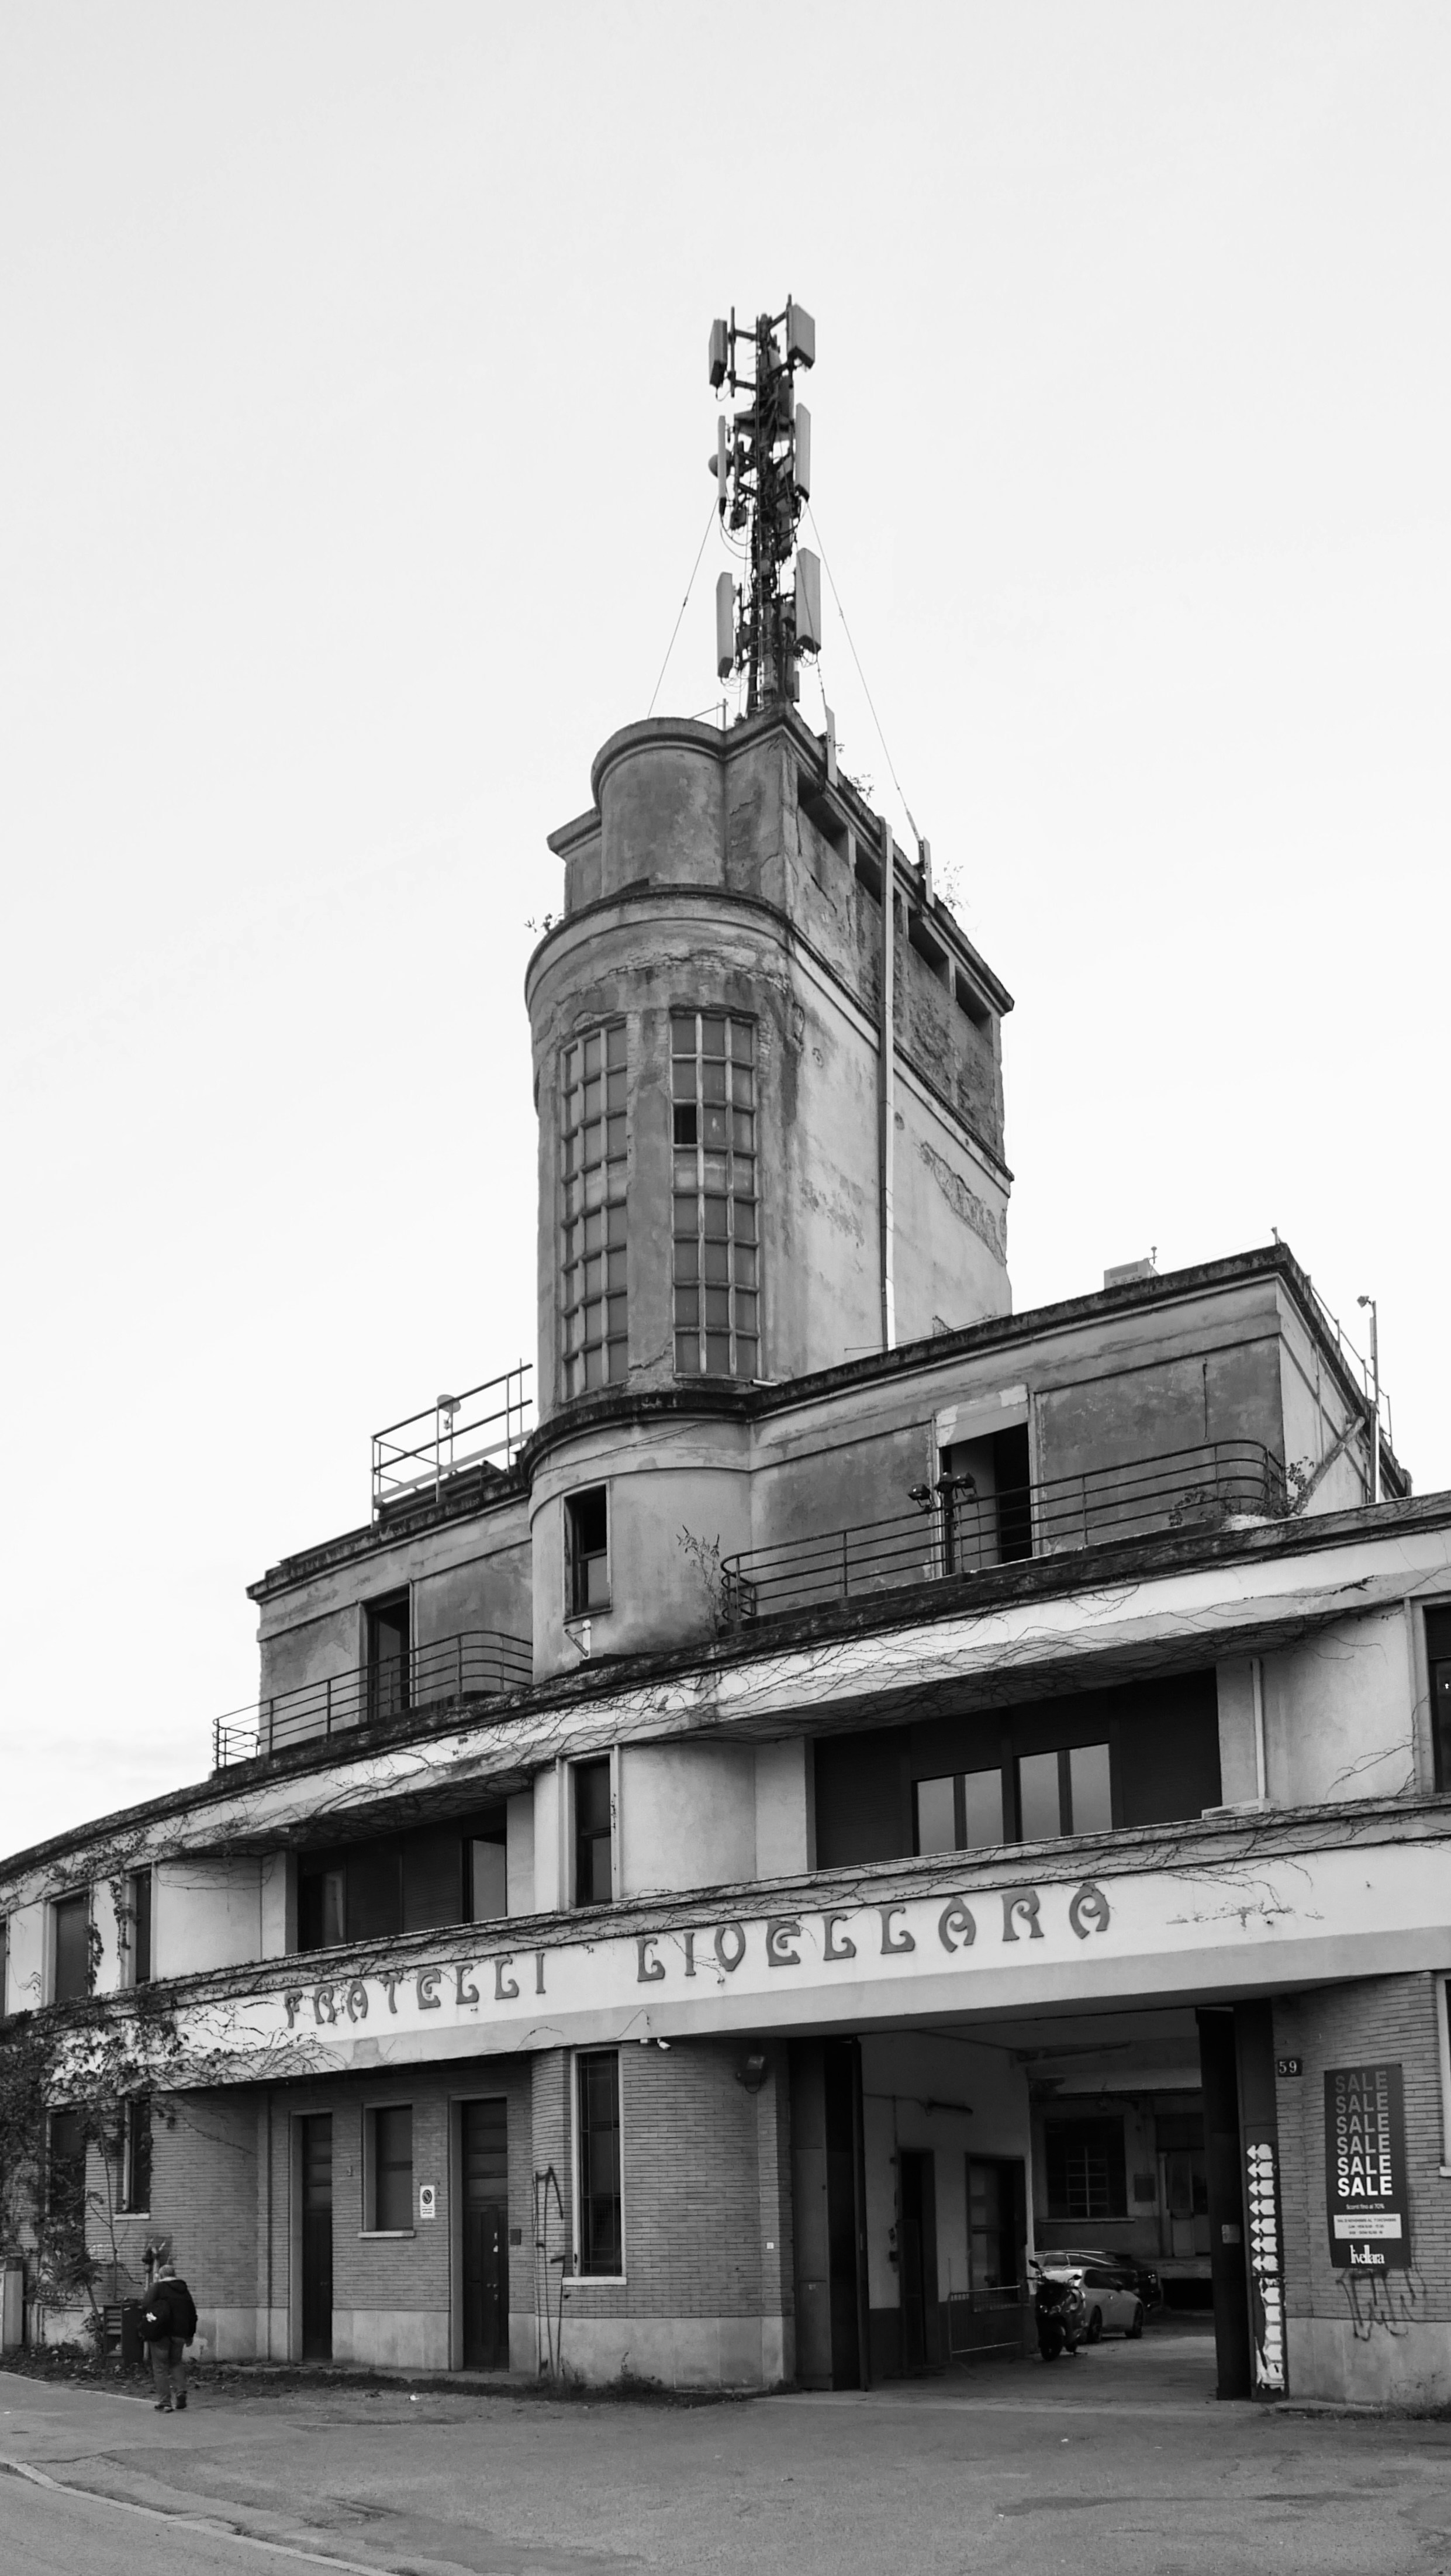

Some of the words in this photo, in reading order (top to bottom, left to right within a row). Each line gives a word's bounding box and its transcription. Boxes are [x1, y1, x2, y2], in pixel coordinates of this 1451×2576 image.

[284, 1952, 546, 2029] FRATELLI
[637, 1882, 1111, 1982] LIVELLARA
[1279, 2060, 1297, 2074] 59
[1335, 2071, 1388, 2094] SALE
[1336, 2091, 1389, 2114] SALE
[1336, 2112, 1390, 2134] SALE
[1337, 2133, 1391, 2156] SALE
[1337, 2154, 1392, 2176] SALE
[1338, 2175, 1393, 2197] SALE
